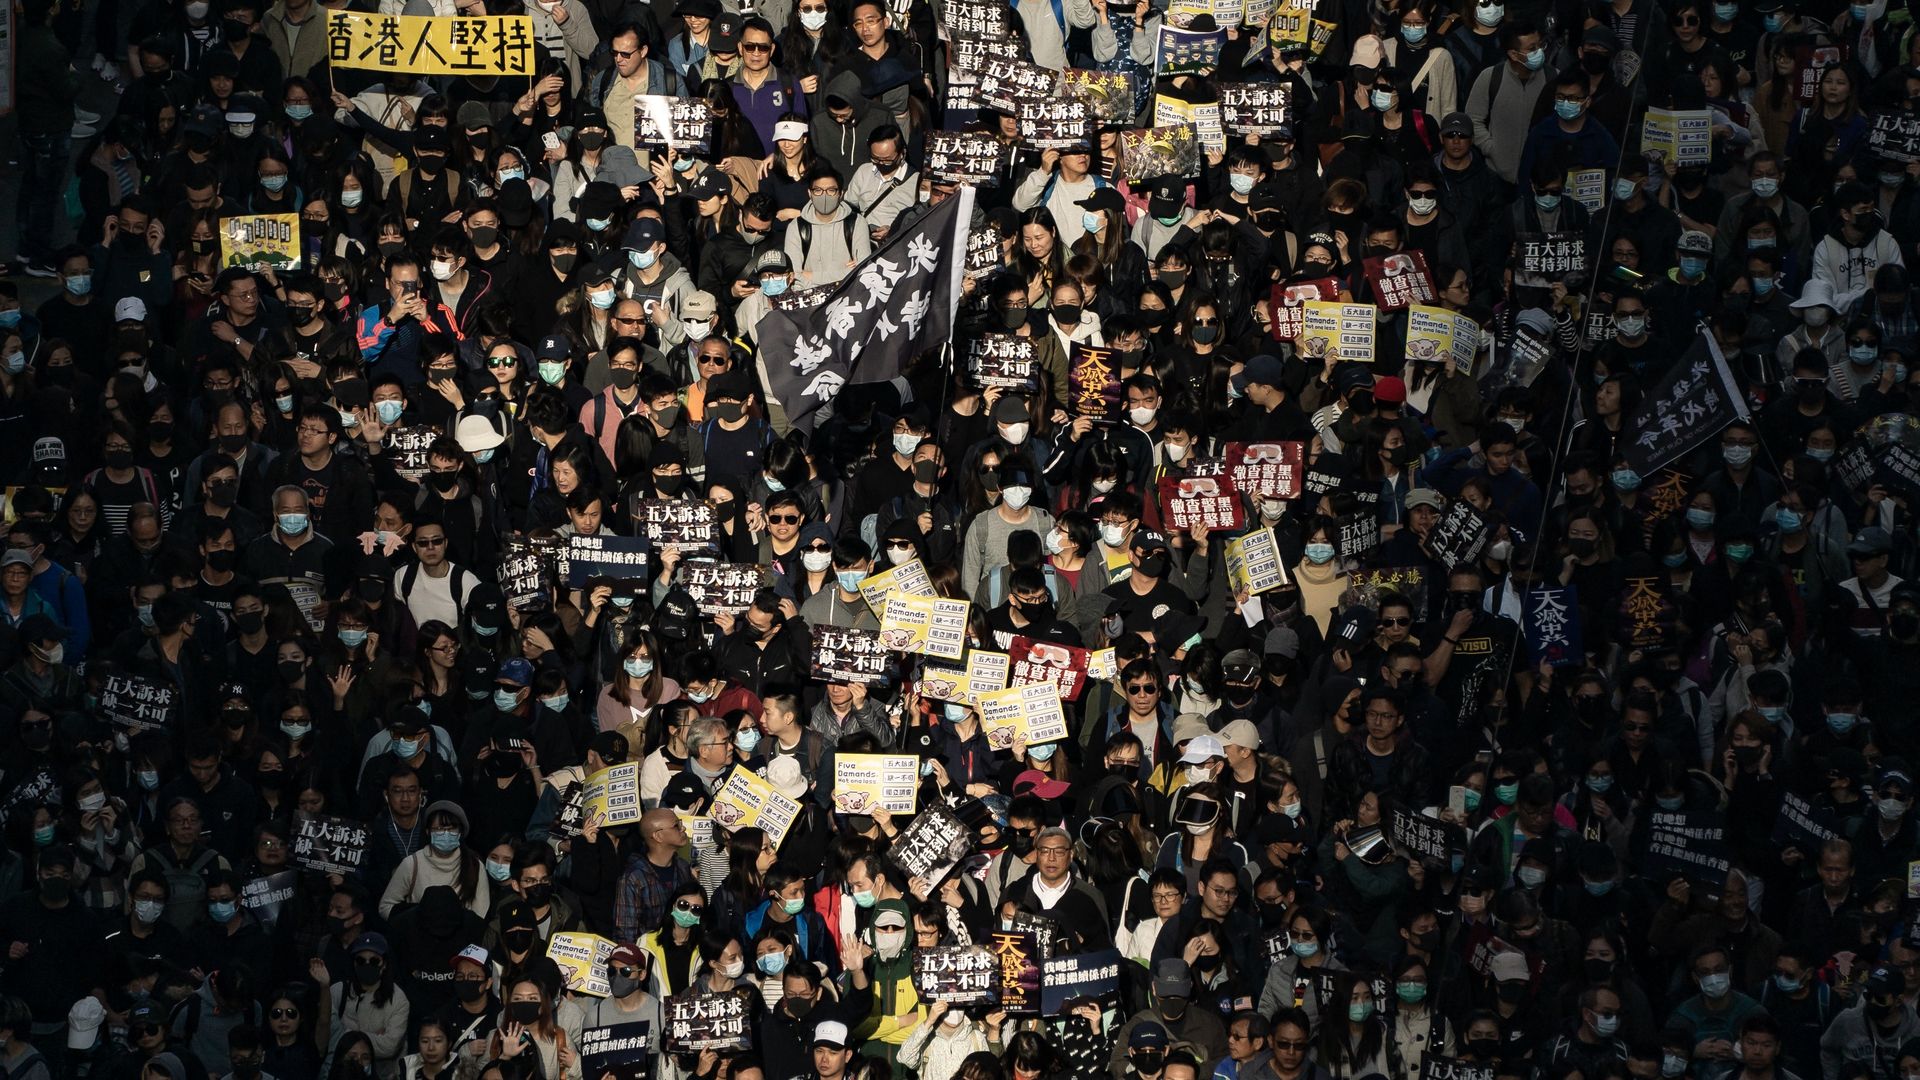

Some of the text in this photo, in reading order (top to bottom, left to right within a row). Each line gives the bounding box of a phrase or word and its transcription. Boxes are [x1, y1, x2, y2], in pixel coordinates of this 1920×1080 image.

[945, 2, 1001, 21] 五大訴求
[945, 15, 1001, 35] 堅持到底
[328, 13, 532, 73] 香港人堅持
[959, 39, 1019, 58] 五大訴求
[987, 60, 1051, 91] 五大訴求
[1065, 71, 1129, 90] 正義必勝
[981, 75, 1048, 98] 缺一不
[772, 91, 783, 107] 3
[1223, 89, 1285, 106] 五大訴求
[642, 103, 707, 120] 訴求
[1022, 103, 1085, 120] 五大訴求
[1224, 107, 1285, 124] 缺一不可
[641, 119, 708, 139] 缺不可
[1021, 120, 1085, 137] 缺一不可
[1127, 125, 1193, 149] 正義必勝
[934, 137, 999, 157] 五大訴求
[931, 152, 998, 173] 缺一不可
[1525, 241, 1584, 257] 五大訴求
[1525, 256, 1584, 272] 堅持到底
[1305, 316, 1338, 325] Demands.
[1411, 319, 1450, 330] Demands.
[1412, 311, 1430, 319] Five
[968, 338, 1032, 359] 五大訴求
[967, 355, 1032, 377] 缺一不可
[1077, 346, 1112, 407] 天滅中共
[388, 432, 437, 450] 大訴求
[648, 506, 711, 523] 五大訴求
[1171, 496, 1233, 514] 徹查警黑
[648, 524, 712, 541] 缺一不可
[571, 536, 602, 549] 我哋想
[571, 550, 646, 565] 香港繼續係香港
[691, 569, 758, 588] 五大訴求
[689, 585, 757, 604] 缺一不可
[889, 600, 907, 608] Five
[887, 607, 928, 619] Demands.
[1530, 589, 1569, 650] 天滅中共
[819, 649, 887, 672] 缺一不可
[105, 674, 172, 705] 五大訴求
[102, 691, 168, 722] 缺一不可
[983, 705, 1020, 716] Demands.
[733, 773, 749, 787] Five
[838, 770, 878, 778] Demands.
[728, 780, 762, 805] Demands.
[298, 819, 366, 846] 五大訴求
[898, 812, 946, 866] 五大訴求
[295, 836, 363, 866] 缺一不可
[908, 824, 959, 877] 堅持到底
[555, 935, 572, 944] Five
[552, 943, 591, 956] Demands.
[922, 953, 991, 972] 五大訴求
[1044, 959, 1078, 974] 我哋想
[421, 970, 456, 981] Polaro
[921, 971, 991, 990] 缺一不可
[1043, 964, 1118, 986] 香港繼續係香港
[673, 998, 742, 1021] 五大訴求
[673, 1018, 744, 1039] 缺一不可
